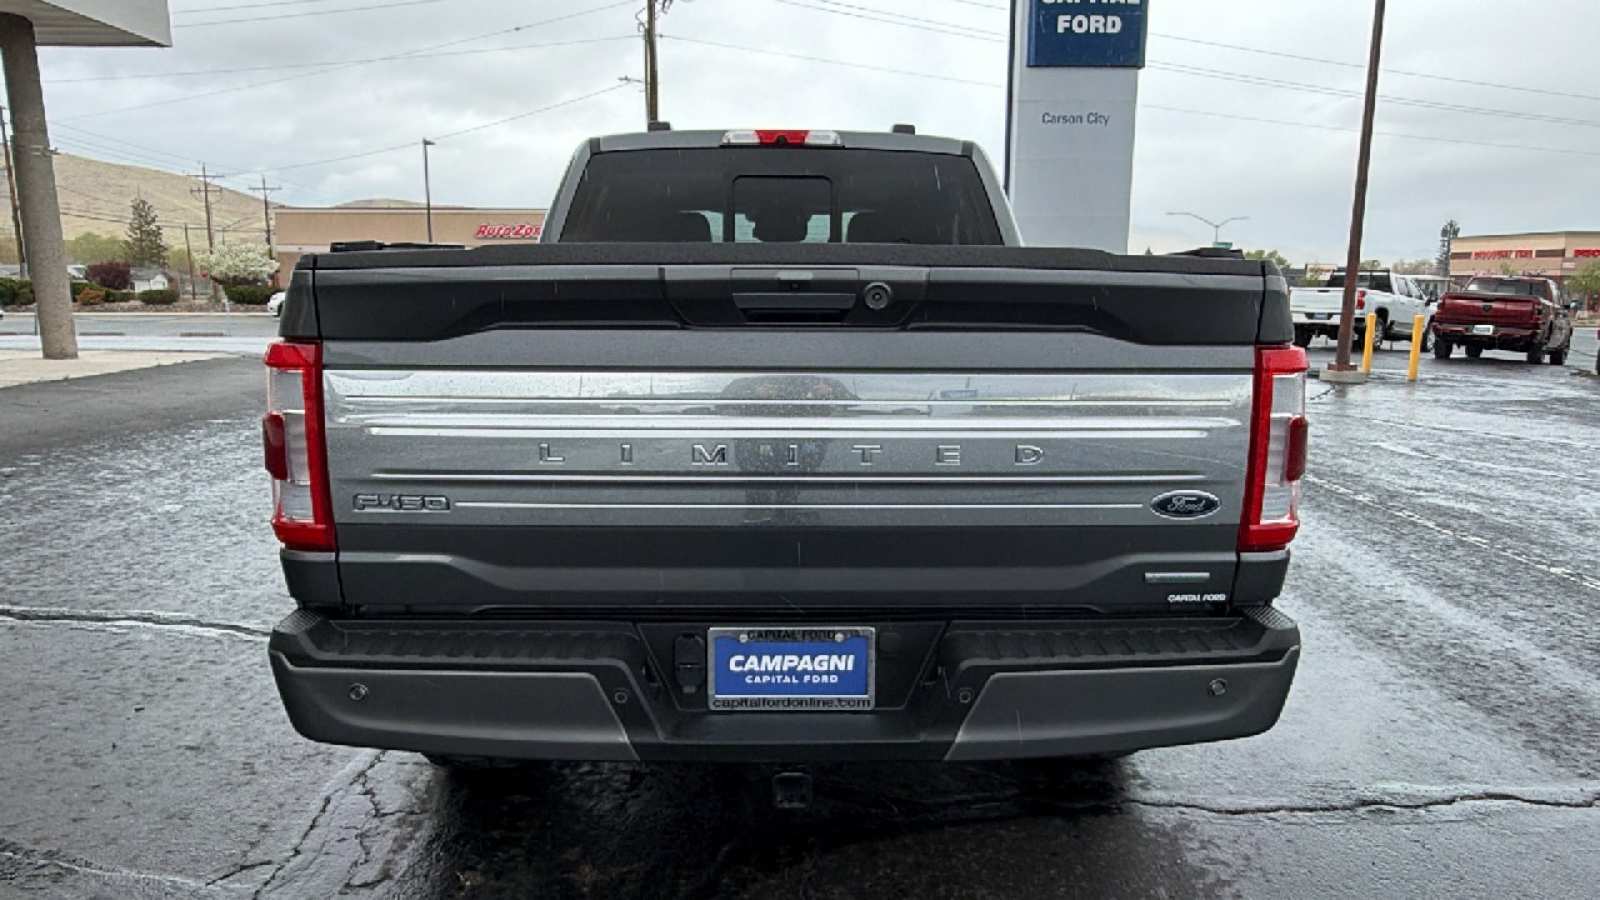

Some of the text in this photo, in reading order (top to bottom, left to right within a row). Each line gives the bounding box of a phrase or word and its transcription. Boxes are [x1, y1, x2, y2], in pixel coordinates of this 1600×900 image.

[1057, 14, 1122, 34] FORD
[1041, 112, 1110, 126] Carson City
[475, 223, 541, 239] AutoZon
[539, 443, 1045, 465] LIMITED
[353, 494, 450, 512] F-150
[1167, 495, 1206, 512] Ford
[1167, 593, 1227, 603] CAPITAL FORD
[747, 629, 836, 640] CAPITAL FORD
[729, 654, 856, 672] CAMPAGNI
[744, 674, 839, 684] CAPITAL FORD
[712, 697, 872, 710] capitalfordonline.com
